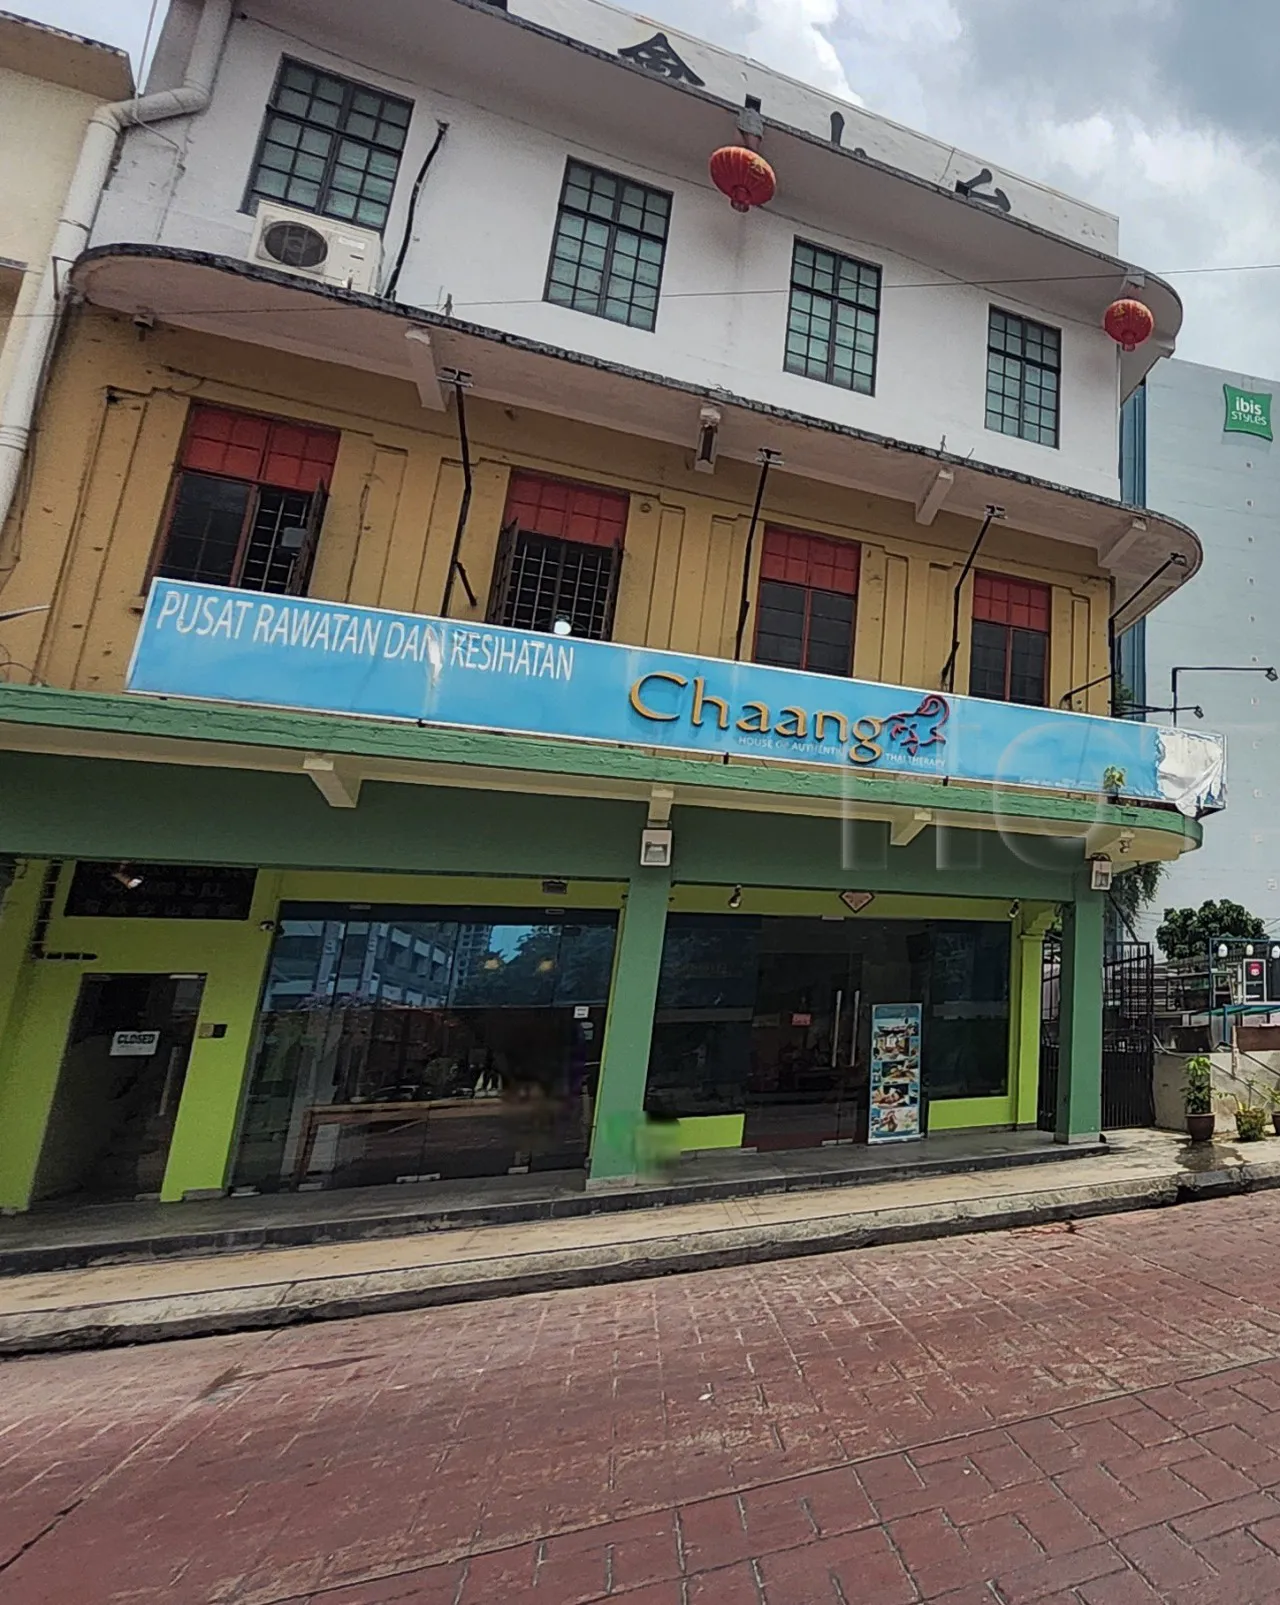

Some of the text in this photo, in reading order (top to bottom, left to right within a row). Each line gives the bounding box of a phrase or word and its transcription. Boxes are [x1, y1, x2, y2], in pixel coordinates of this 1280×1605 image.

[1236, 397, 1262, 415] ibis
[156, 591, 575, 681] PUSAT RAWATAN DAN KESIHATAN
[629, 671, 885, 764] Chaang
[738, 736, 773, 749] HOUSE
[885, 752, 906, 763] THAI
[907, 756, 946, 768] THERAPY
[117, 1034, 155, 1044] CLOSED
